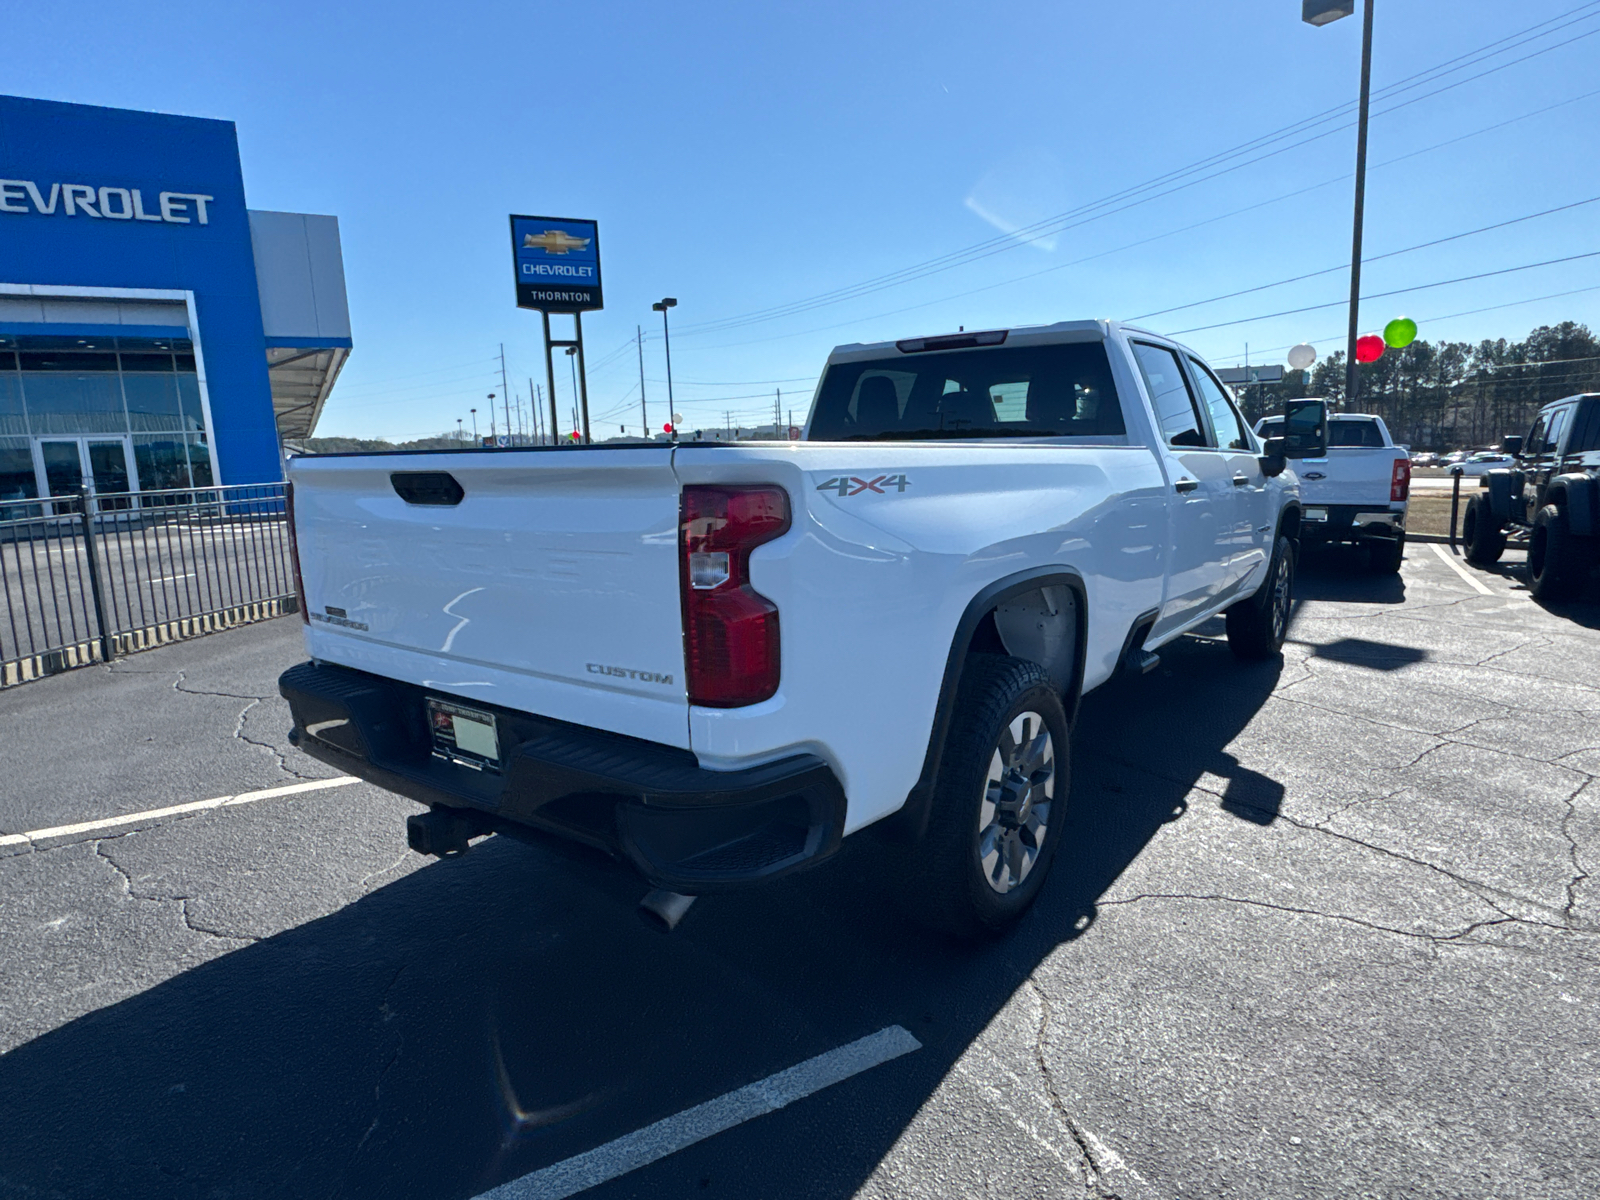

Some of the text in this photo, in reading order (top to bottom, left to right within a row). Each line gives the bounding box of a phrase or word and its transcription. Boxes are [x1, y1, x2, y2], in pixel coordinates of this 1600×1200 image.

[0, 178, 214, 225] EVROLET
[522, 263, 593, 277] CHEVROLET
[531, 290, 591, 302] THORNTON
[586, 663, 674, 685] CUSTOM
